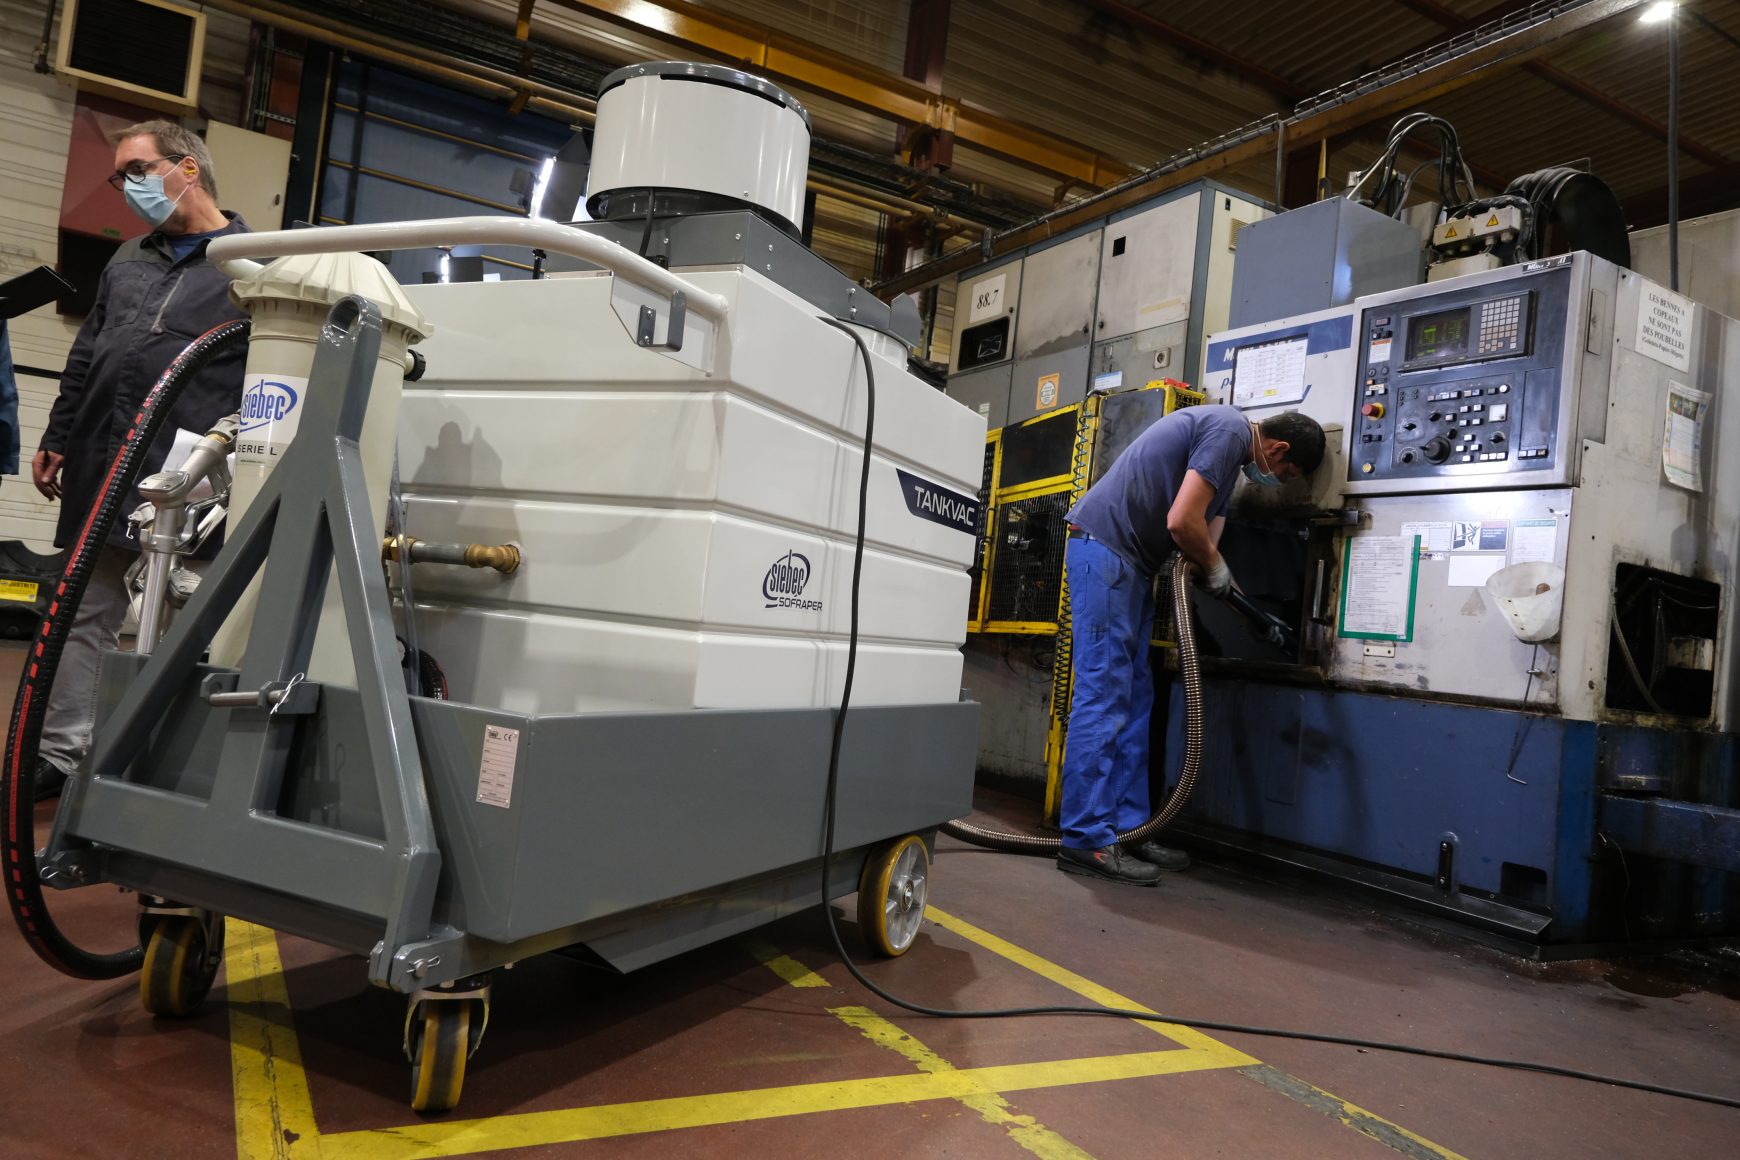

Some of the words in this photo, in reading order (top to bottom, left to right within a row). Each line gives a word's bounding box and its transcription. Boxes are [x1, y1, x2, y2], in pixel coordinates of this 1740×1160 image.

[977, 289, 999, 310] 88.7
[1649, 292, 1659, 304] LES
[1660, 298, 1680, 314] BENNES
[1649, 316, 1656, 326] NE
[1657, 320, 1671, 333] SONT
[1671, 326, 1682, 338] PAS
[1653, 307, 1679, 326] COPEAUX
[1643, 325, 1654, 337] DES
[1654, 330, 1685, 351] POUBELLES
[237, 444, 264, 454] SERIE
[270, 447, 277, 456] L
[914, 485, 975, 527] TANKVAC
[778, 596, 823, 611] SOFRAPER
